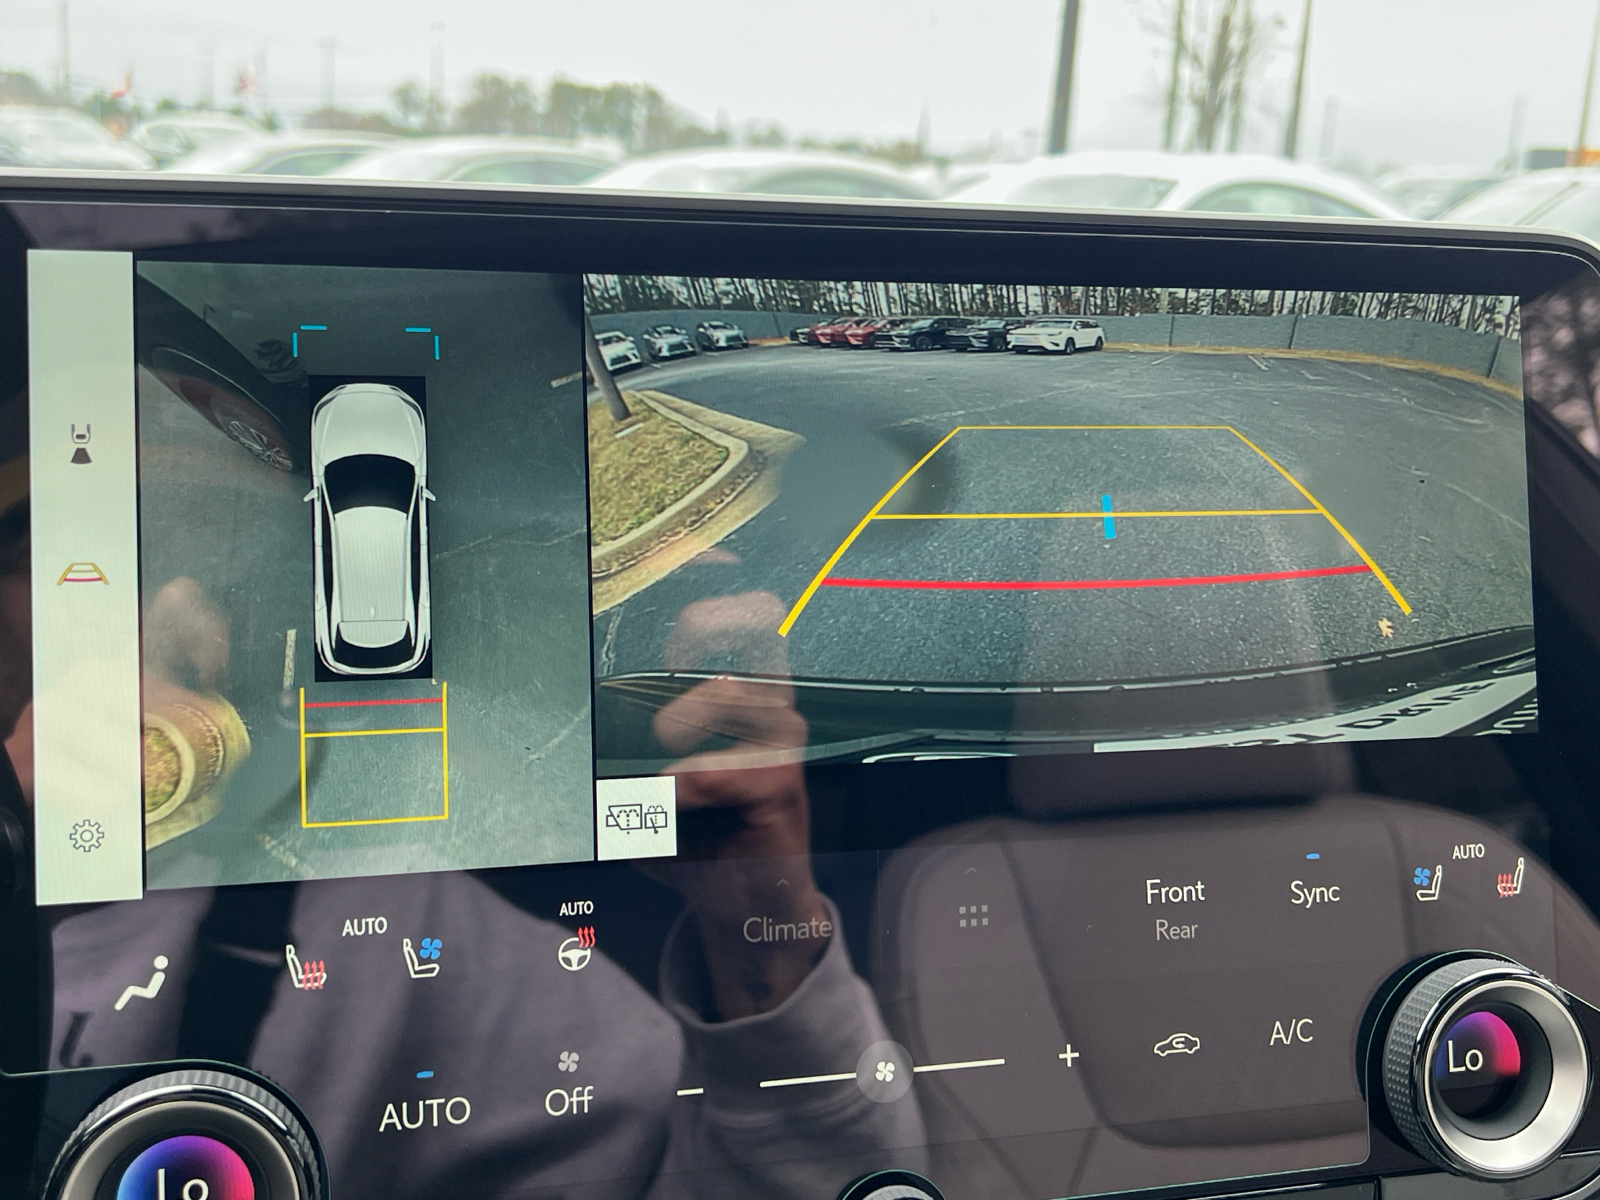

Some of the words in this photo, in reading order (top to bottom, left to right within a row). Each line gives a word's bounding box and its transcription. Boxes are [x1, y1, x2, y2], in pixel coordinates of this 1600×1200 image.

[1452, 843, 1485, 860] AUTO
[1146, 878, 1206, 905] Front
[1290, 880, 1341, 909] Sync
[559, 900, 594, 917] AUTO
[341, 916, 388, 937] AUTO
[743, 916, 833, 943] Climate
[1155, 919, 1199, 941] Rear
[1269, 1018, 1314, 1046] A/C
[1447, 1039, 1484, 1073] Lo
[378, 1096, 471, 1133] AUTO
[545, 1085, 594, 1117] Off
